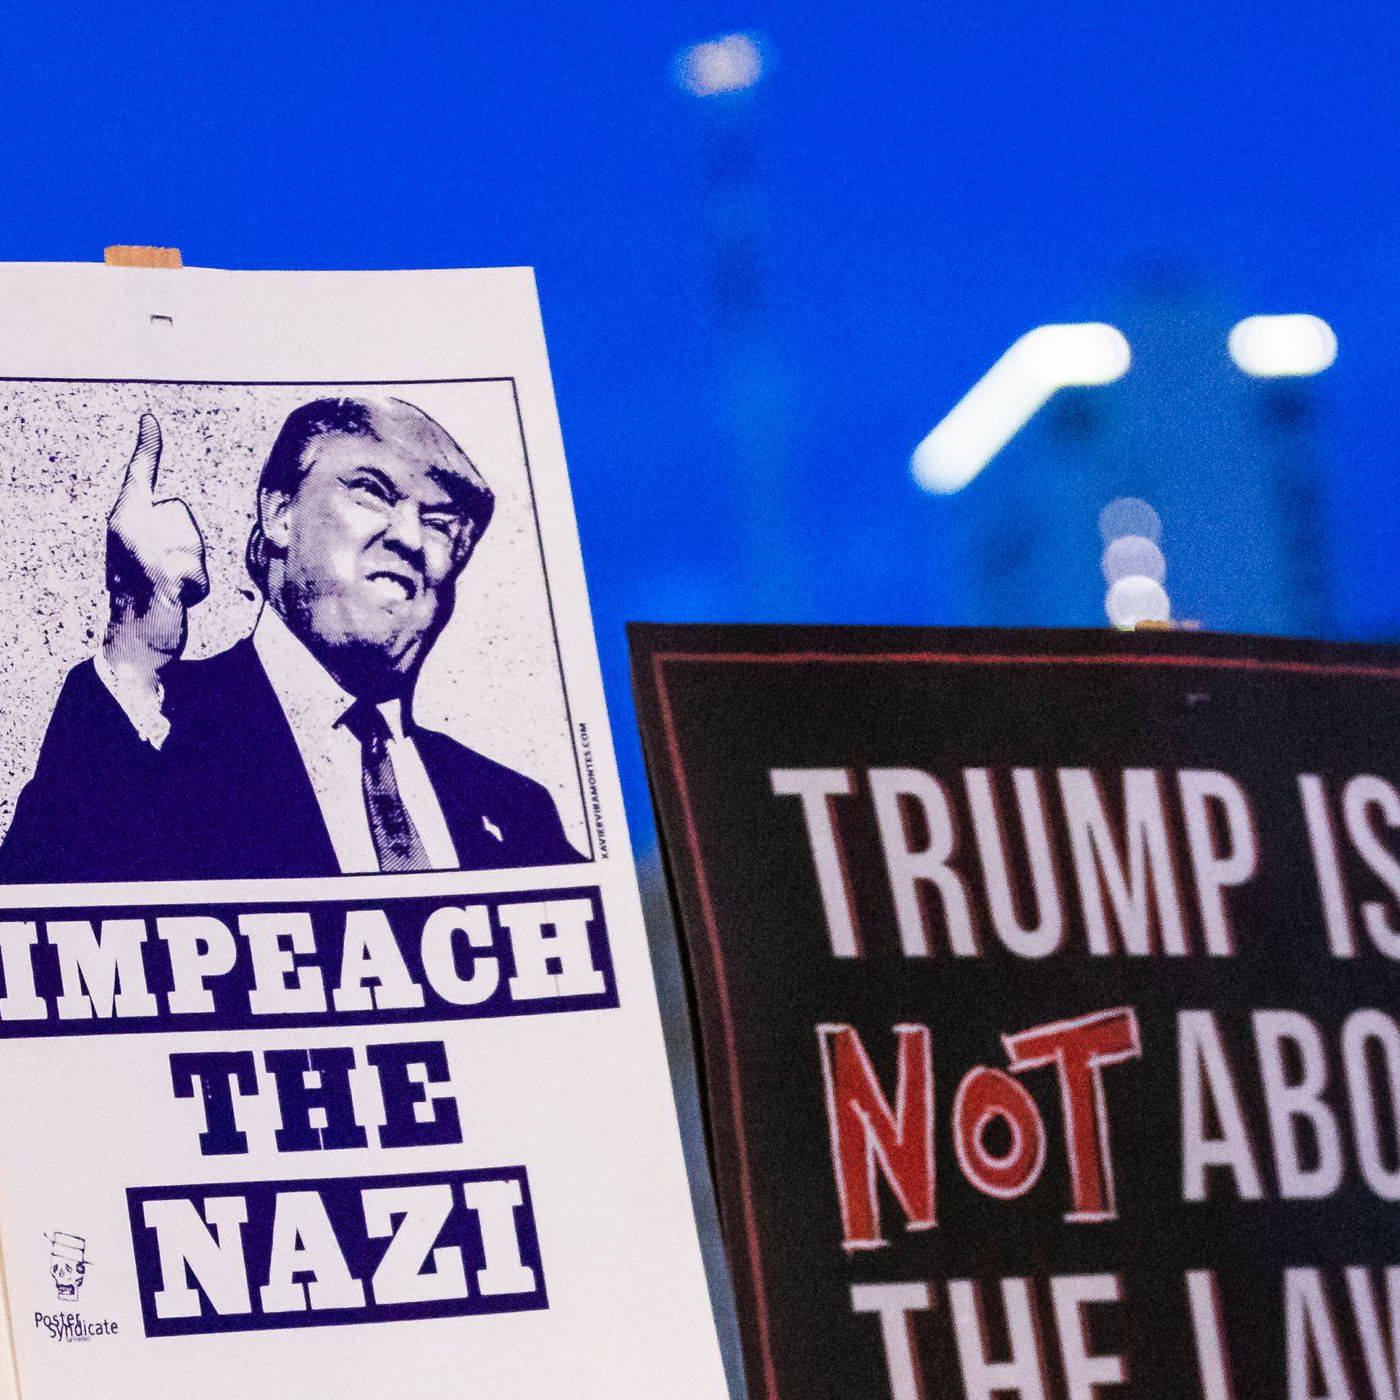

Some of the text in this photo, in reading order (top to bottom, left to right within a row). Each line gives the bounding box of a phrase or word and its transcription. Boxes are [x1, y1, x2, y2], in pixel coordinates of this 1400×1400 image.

[768, 765, 1261, 959] TRUMP
[169, 1040, 464, 1156] THE
[141, 1178, 537, 1320] NAZI
[34, 1311, 81, 1328] Poster
[48, 1319, 119, 1342] Syndicate
